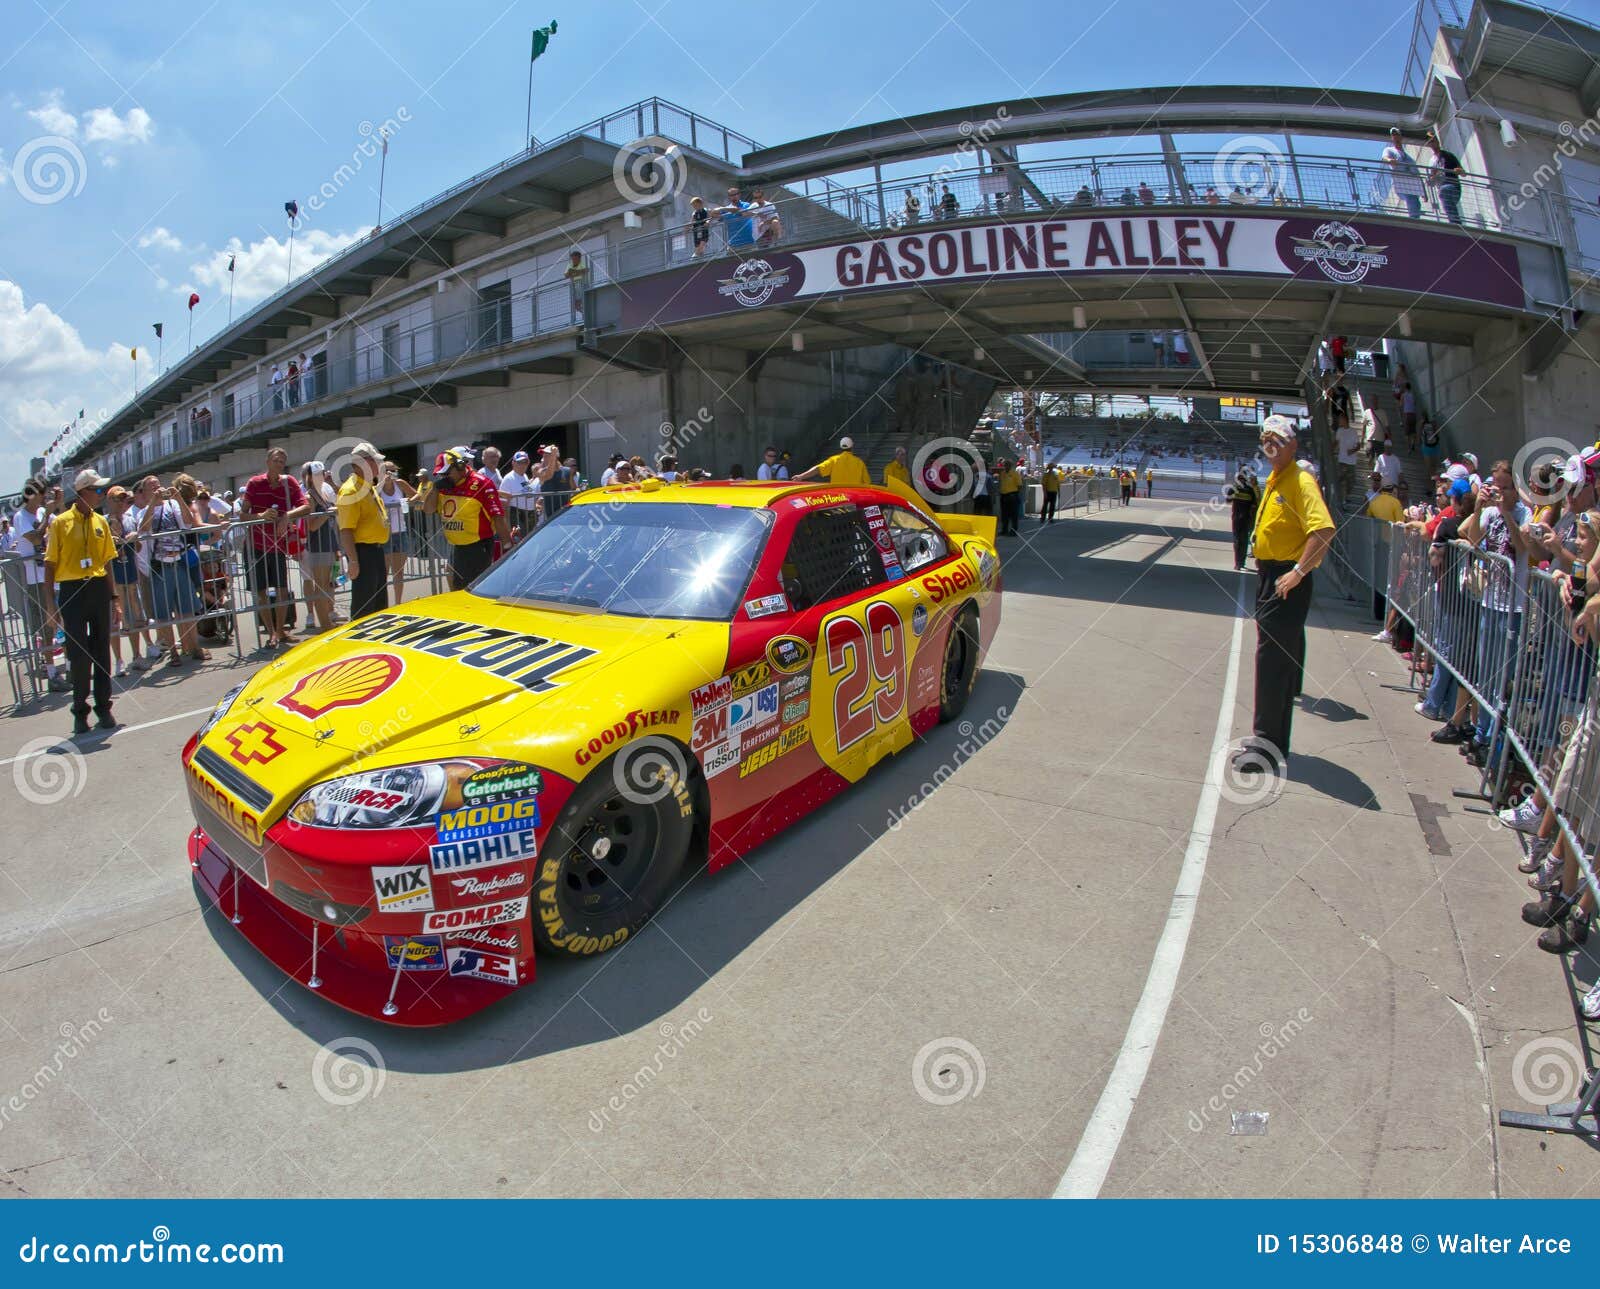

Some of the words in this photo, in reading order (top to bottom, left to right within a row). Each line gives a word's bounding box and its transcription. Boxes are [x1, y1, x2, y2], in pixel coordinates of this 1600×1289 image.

[836, 224, 1070, 287] GASOLINE
[1084, 220, 1237, 268] ALLEY
[906, 586, 920, 599] 3
[922, 563, 976, 604] Shell
[329, 614, 599, 692] PENNZOIL
[826, 600, 907, 753] 29
[691, 681, 731, 709] Holley
[574, 709, 680, 766] GOODYEAR
[692, 707, 727, 749] 3M
[743, 725, 779, 751] CRAFTSMAN
[471, 765, 527, 781] GOODYEAR
[704, 747, 740, 773] TISSOT
[739, 741, 778, 778] JEGS
[463, 773, 541, 798] Gatorback
[471, 787, 539, 805] BELTS
[656, 764, 694, 818] EAGLE
[189, 764, 261, 844] IMPALA
[350, 789, 403, 810] RCR
[439, 799, 536, 833] MOOG
[444, 826, 494, 842] CHASSIS
[500, 818, 535, 833] PARTS
[433, 831, 535, 869] MAHLE
[375, 868, 427, 897] WIX
[380, 894, 431, 911] FILTERS
[539, 858, 629, 954] GOODYEAR
[429, 904, 503, 930] COMP
[480, 913, 516, 926] CAMS
[446, 930, 518, 949] Edelbrock
[451, 950, 510, 977] JE
[471, 971, 517, 985] PISTONS
